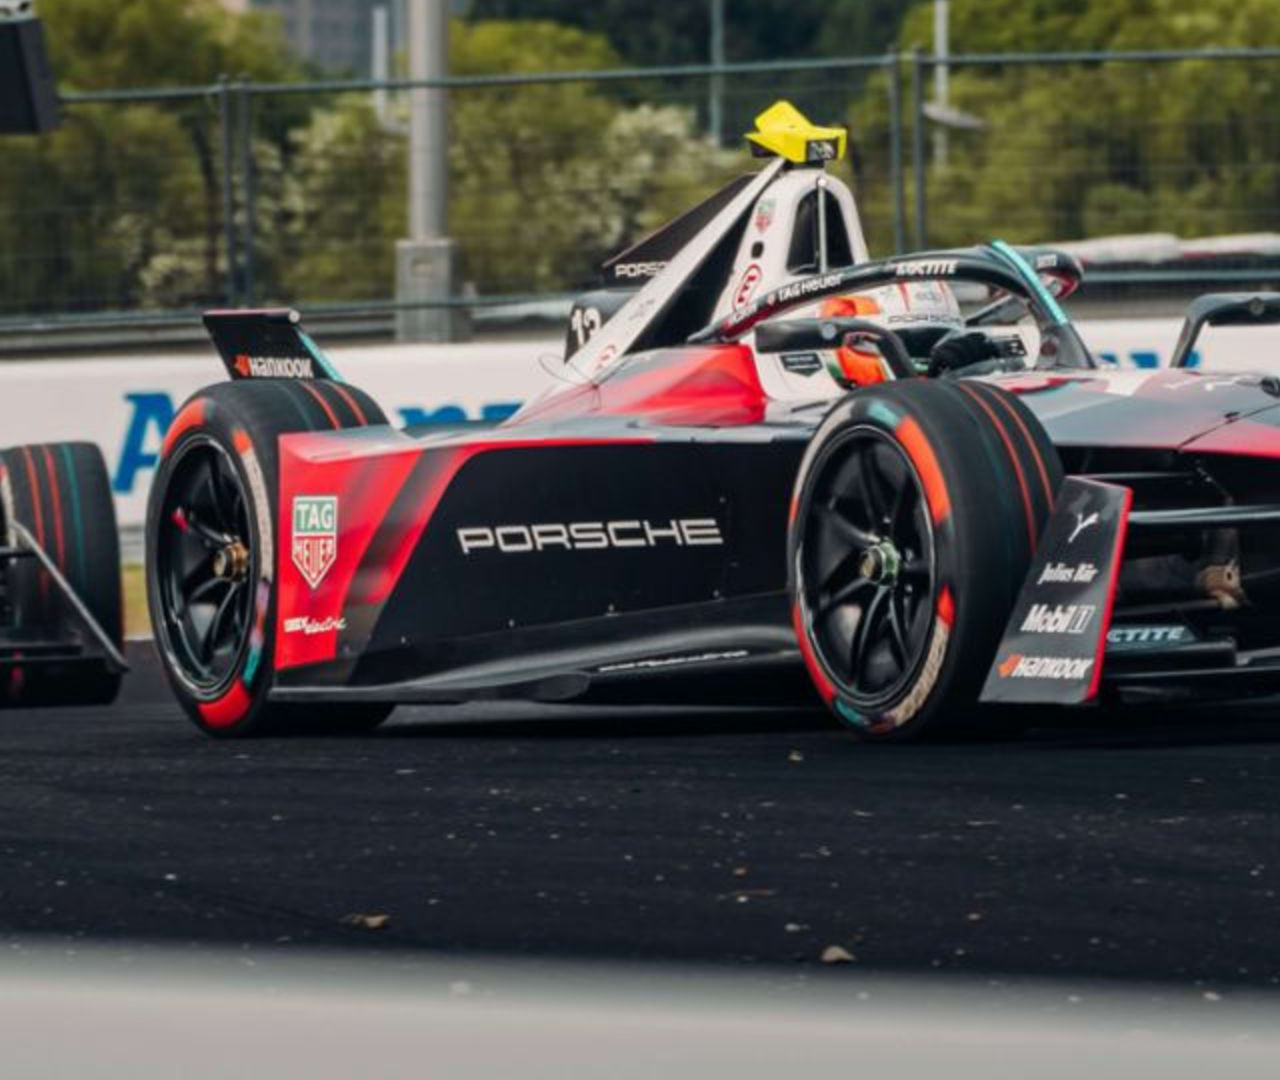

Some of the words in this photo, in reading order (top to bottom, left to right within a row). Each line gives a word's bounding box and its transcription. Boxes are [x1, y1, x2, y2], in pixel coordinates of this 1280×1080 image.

[614, 262, 667, 277] PORS
[296, 503, 333, 529] TAG
[457, 518, 724, 555] PORSCHE
[294, 538, 334, 579] HEUER
[1020, 604, 1077, 633] Mobil
[1107, 626, 1185, 642] CTITE
